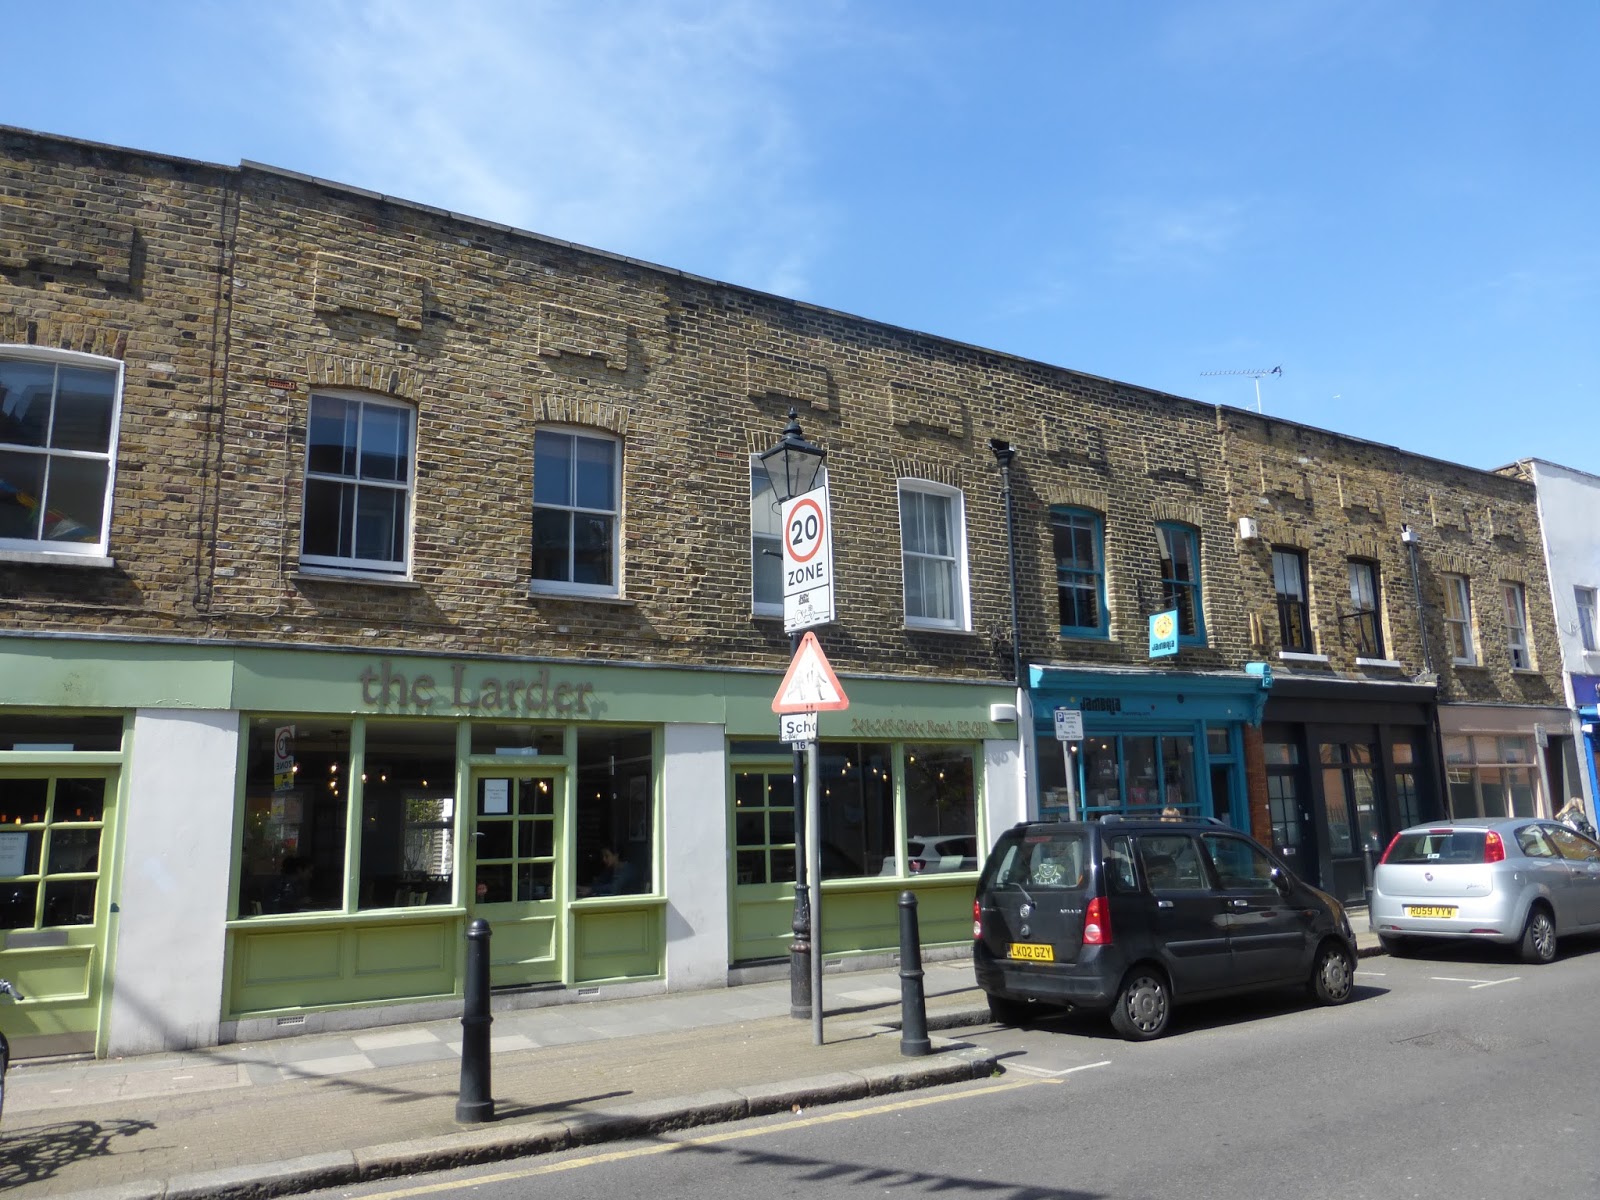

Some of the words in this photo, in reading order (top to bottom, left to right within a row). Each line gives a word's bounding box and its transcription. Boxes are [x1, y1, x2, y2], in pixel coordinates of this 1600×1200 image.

[792, 515, 818, 546] 20
[788, 562, 824, 587] ZONE
[359, 660, 435, 707] the
[451, 663, 593, 713] Larder
[796, 741, 806, 750] 16
[1011, 945, 1033, 958] LK02
[1034, 947, 1051, 959] GZY
